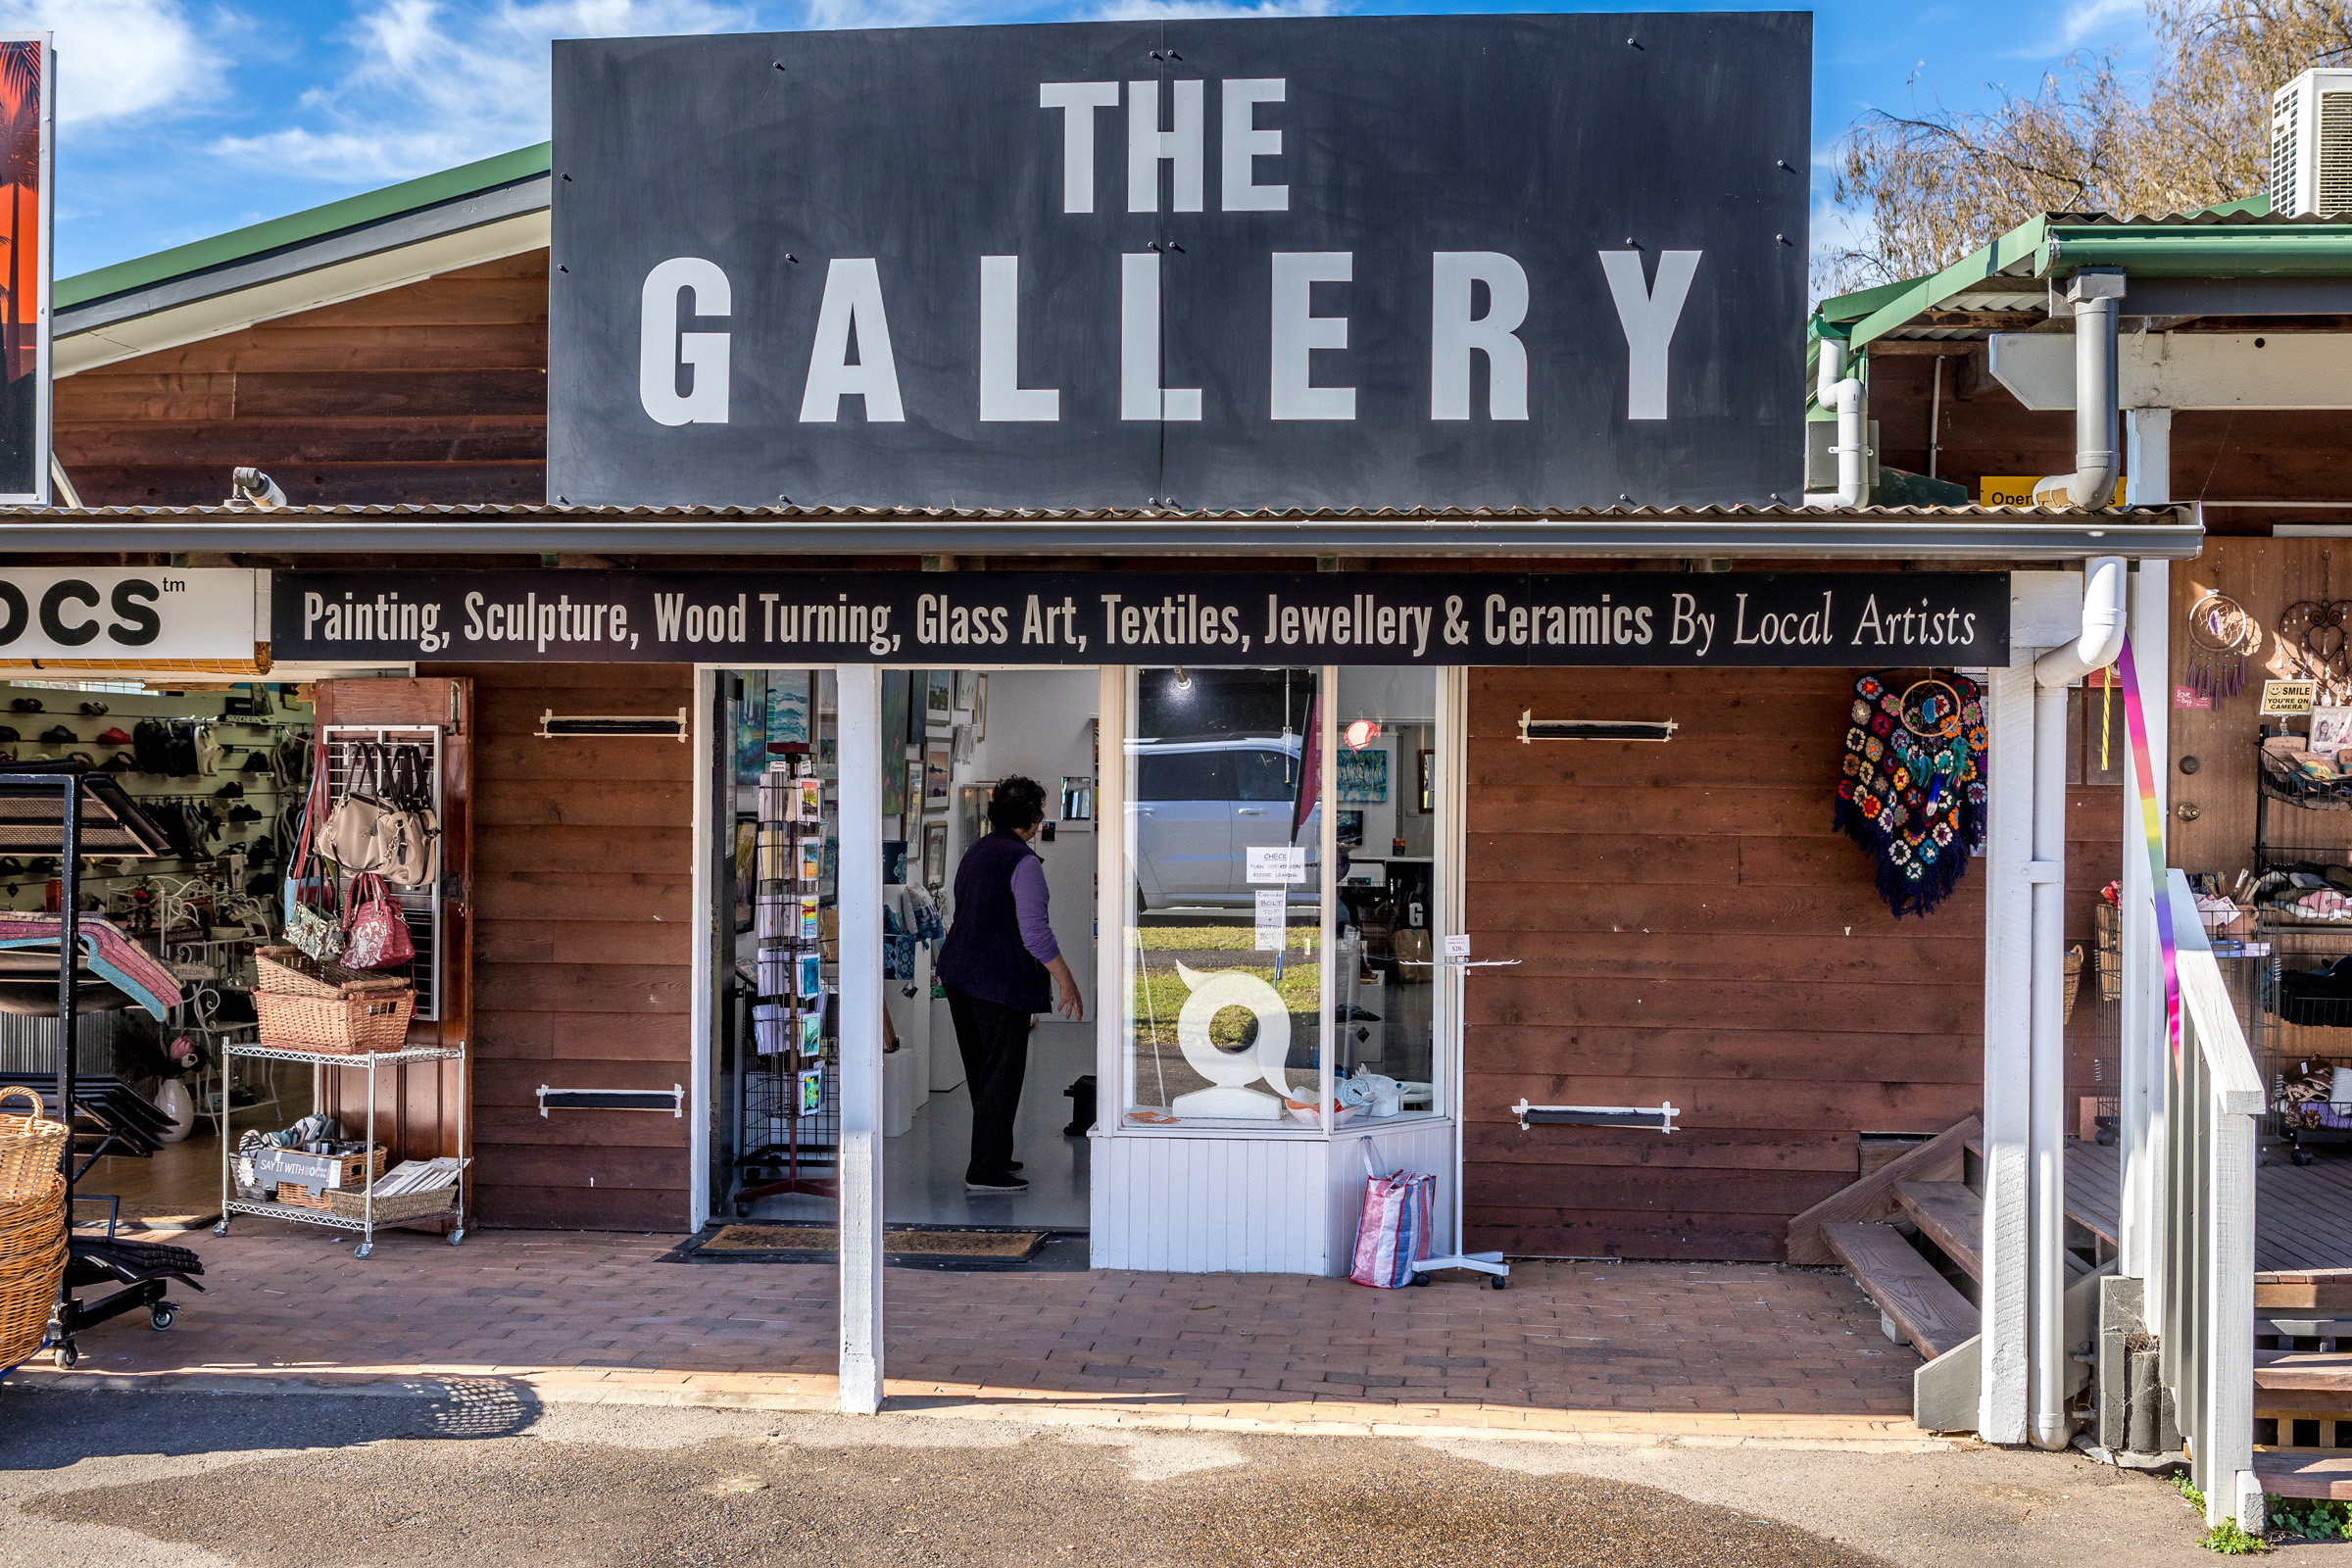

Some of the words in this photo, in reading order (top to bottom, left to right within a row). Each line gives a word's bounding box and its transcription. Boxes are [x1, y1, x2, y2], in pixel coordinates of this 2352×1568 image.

[1040, 77, 1290, 214] THE
[639, 250, 1703, 427] GALLERY
[163, 575, 185, 593] tm
[303, 591, 450, 653] Painting,
[464, 590, 639, 653] Sculpture,
[654, 592, 746, 643] Wood
[759, 593, 901, 656] Turning,
[916, 593, 1008, 645] Glass
[1021, 594, 1088, 654] Art,
[1101, 594, 1250, 654] Textiles,
[1264, 594, 1433, 658] Jewellery
[1444, 595, 1470, 645] &
[1484, 593, 1652, 646] Ceramics
[1669, 592, 1715, 658] By
[1732, 590, 1835, 646] Local
[1849, 592, 1977, 647] Artists
[2282, 686, 2310, 696] SMILE
[1408, 902, 1424, 927] G
[260, 1158, 276, 1171] SAY
[275, 1160, 284, 1172] IT
[284, 1162, 305, 1176] WITH
